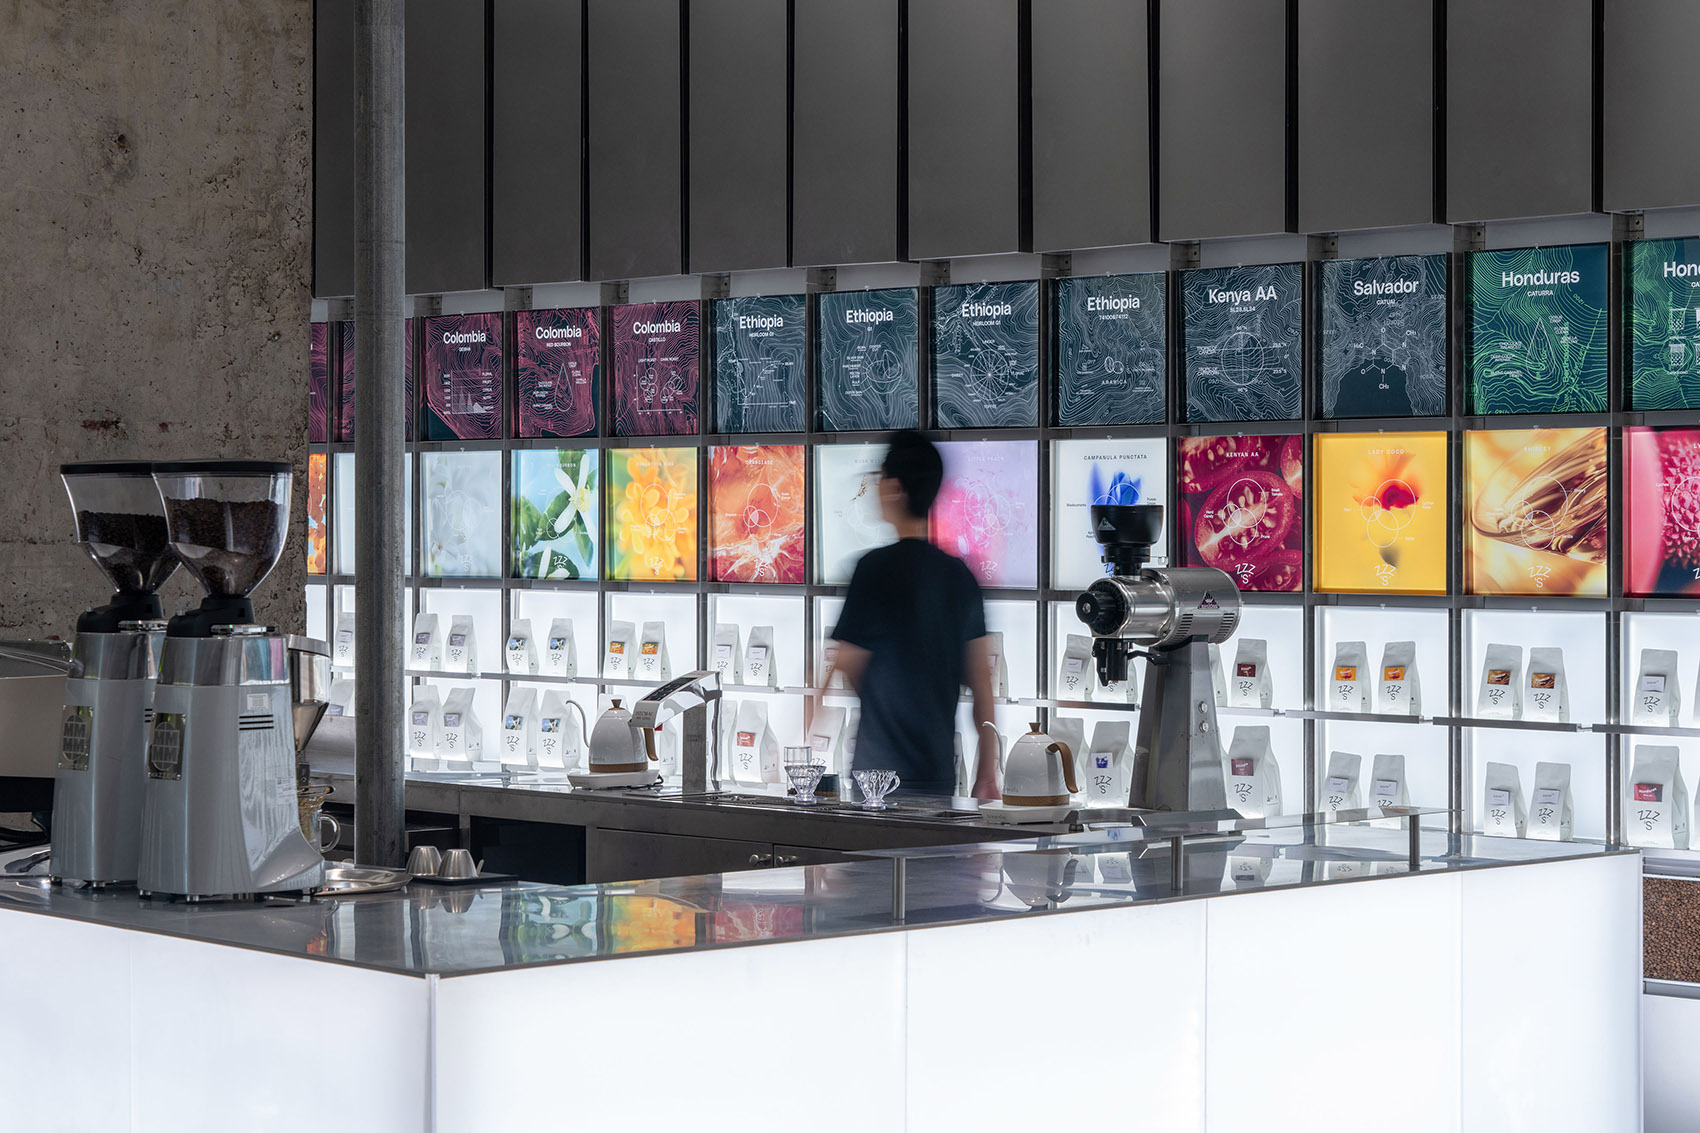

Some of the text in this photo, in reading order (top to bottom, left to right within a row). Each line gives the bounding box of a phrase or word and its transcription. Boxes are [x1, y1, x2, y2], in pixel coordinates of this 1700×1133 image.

[1502, 269, 1580, 287] Honduras
[1354, 278, 1419, 296] Salvador
[1209, 286, 1277, 305] Kenya AA
[1087, 294, 1140, 312] Ethiopia
[846, 308, 893, 325] Ethiopia
[962, 302, 1011, 319] Ethiopia
[633, 320, 681, 334] Colombia
[739, 314, 783, 330] Ethiopia
[443, 330, 486, 344] Colombia
[536, 325, 582, 339] Colombia
[1235, 563, 1256, 575] ZZZ
[1374, 564, 1396, 576] ZZZ
[1528, 566, 1551, 578] ZZZ
[1338, 685, 1354, 694] ZZZ
[1386, 685, 1402, 694] ZZZ
[1488, 689, 1505, 698] ZZZ
[1534, 693, 1551, 702] ZZZ
[1644, 696, 1660, 706] ZZZ
[1094, 775, 1112, 786] ZZZ
[1234, 784, 1253, 794] ZZZ
[1491, 809, 1506, 818] ZZZ
[1539, 808, 1554, 817] ZZZ
[1638, 810, 1660, 822] ZZZ
